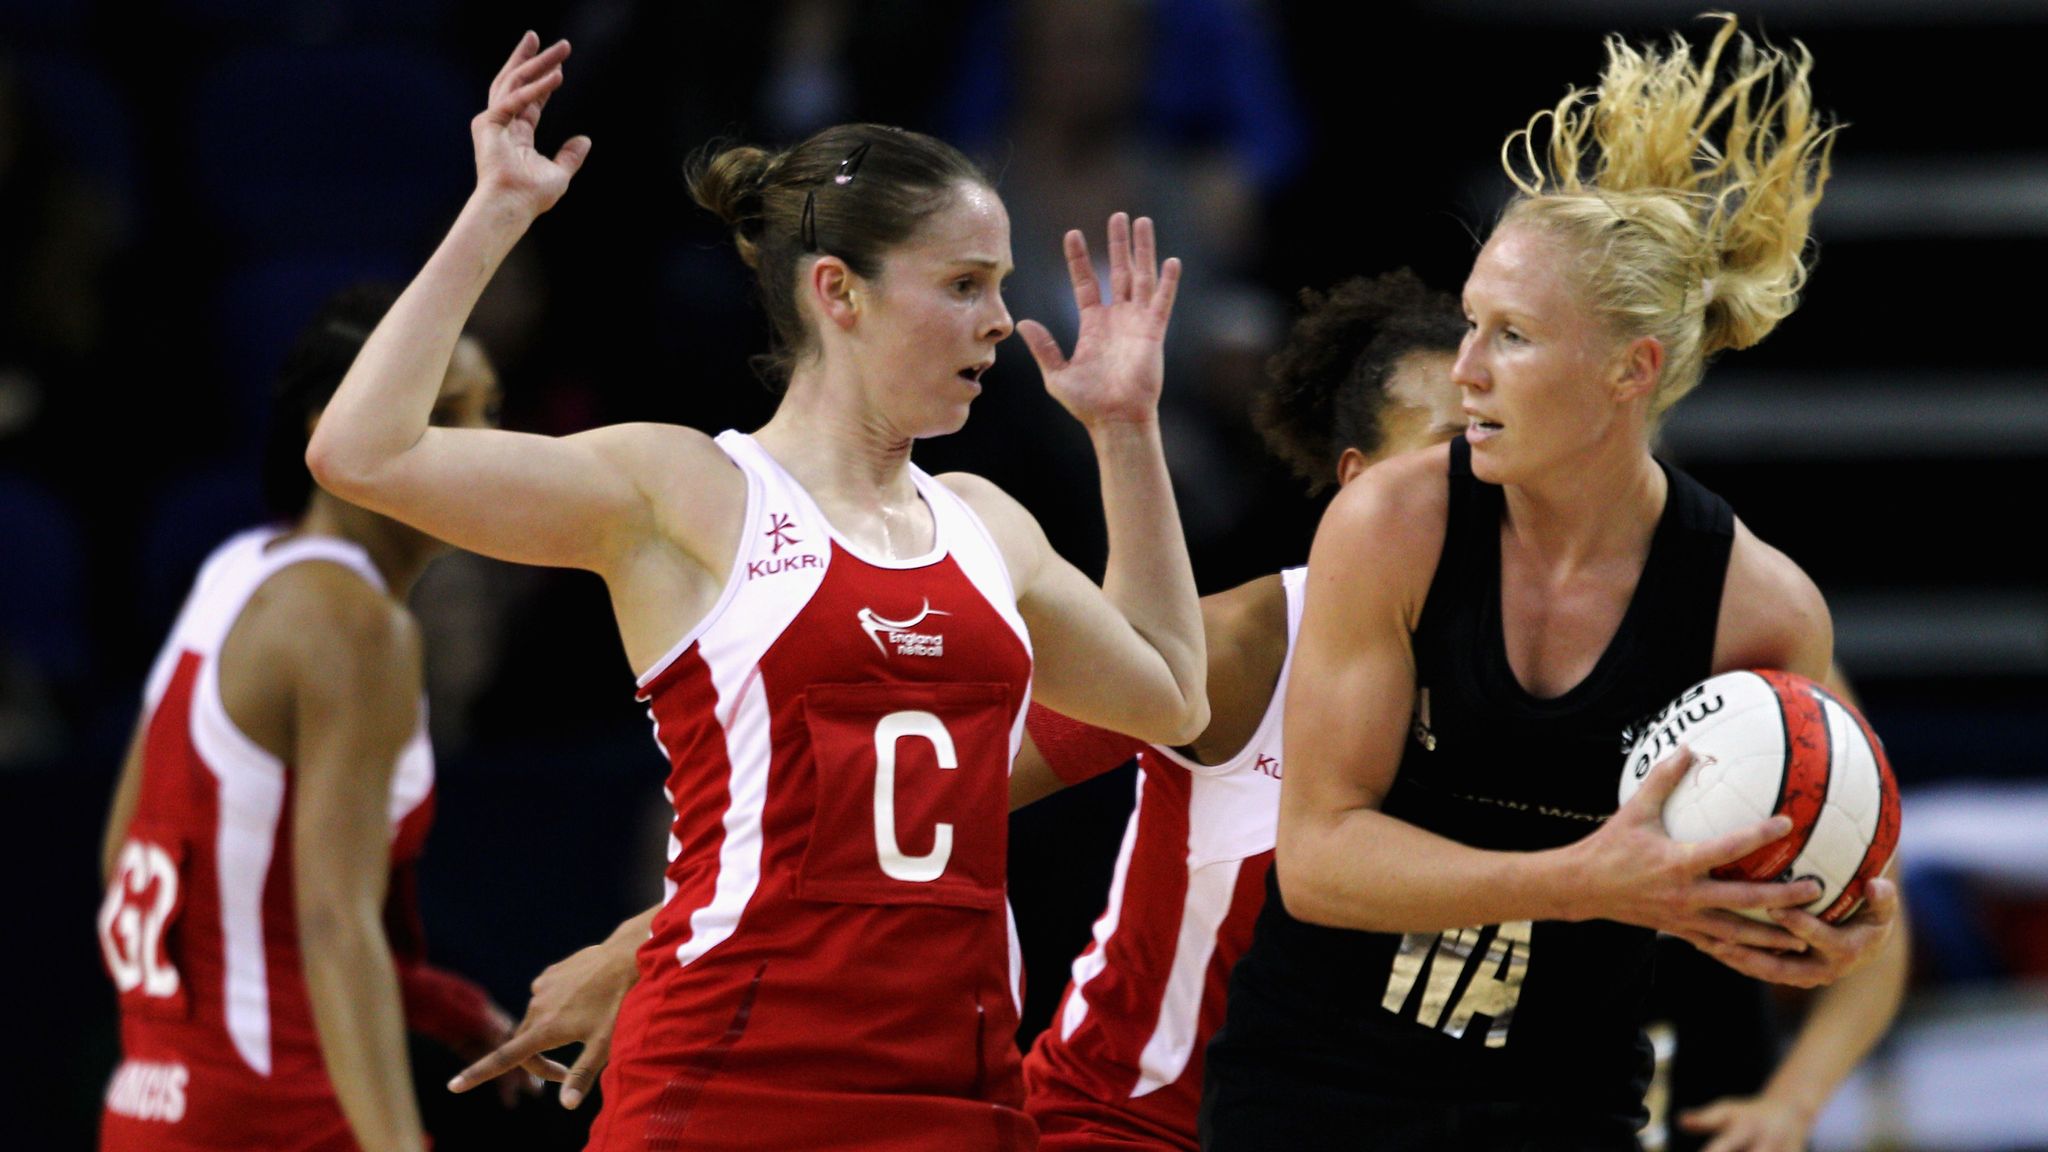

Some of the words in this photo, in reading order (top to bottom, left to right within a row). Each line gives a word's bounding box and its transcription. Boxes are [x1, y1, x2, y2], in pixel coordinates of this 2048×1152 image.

[747, 554, 824, 581] KUKRI
[889, 632, 943, 647] England
[897, 645, 944, 657] netball
[1634, 694, 1725, 781] mitre
[873, 709, 958, 883] C
[1381, 920, 1533, 1049] WA
